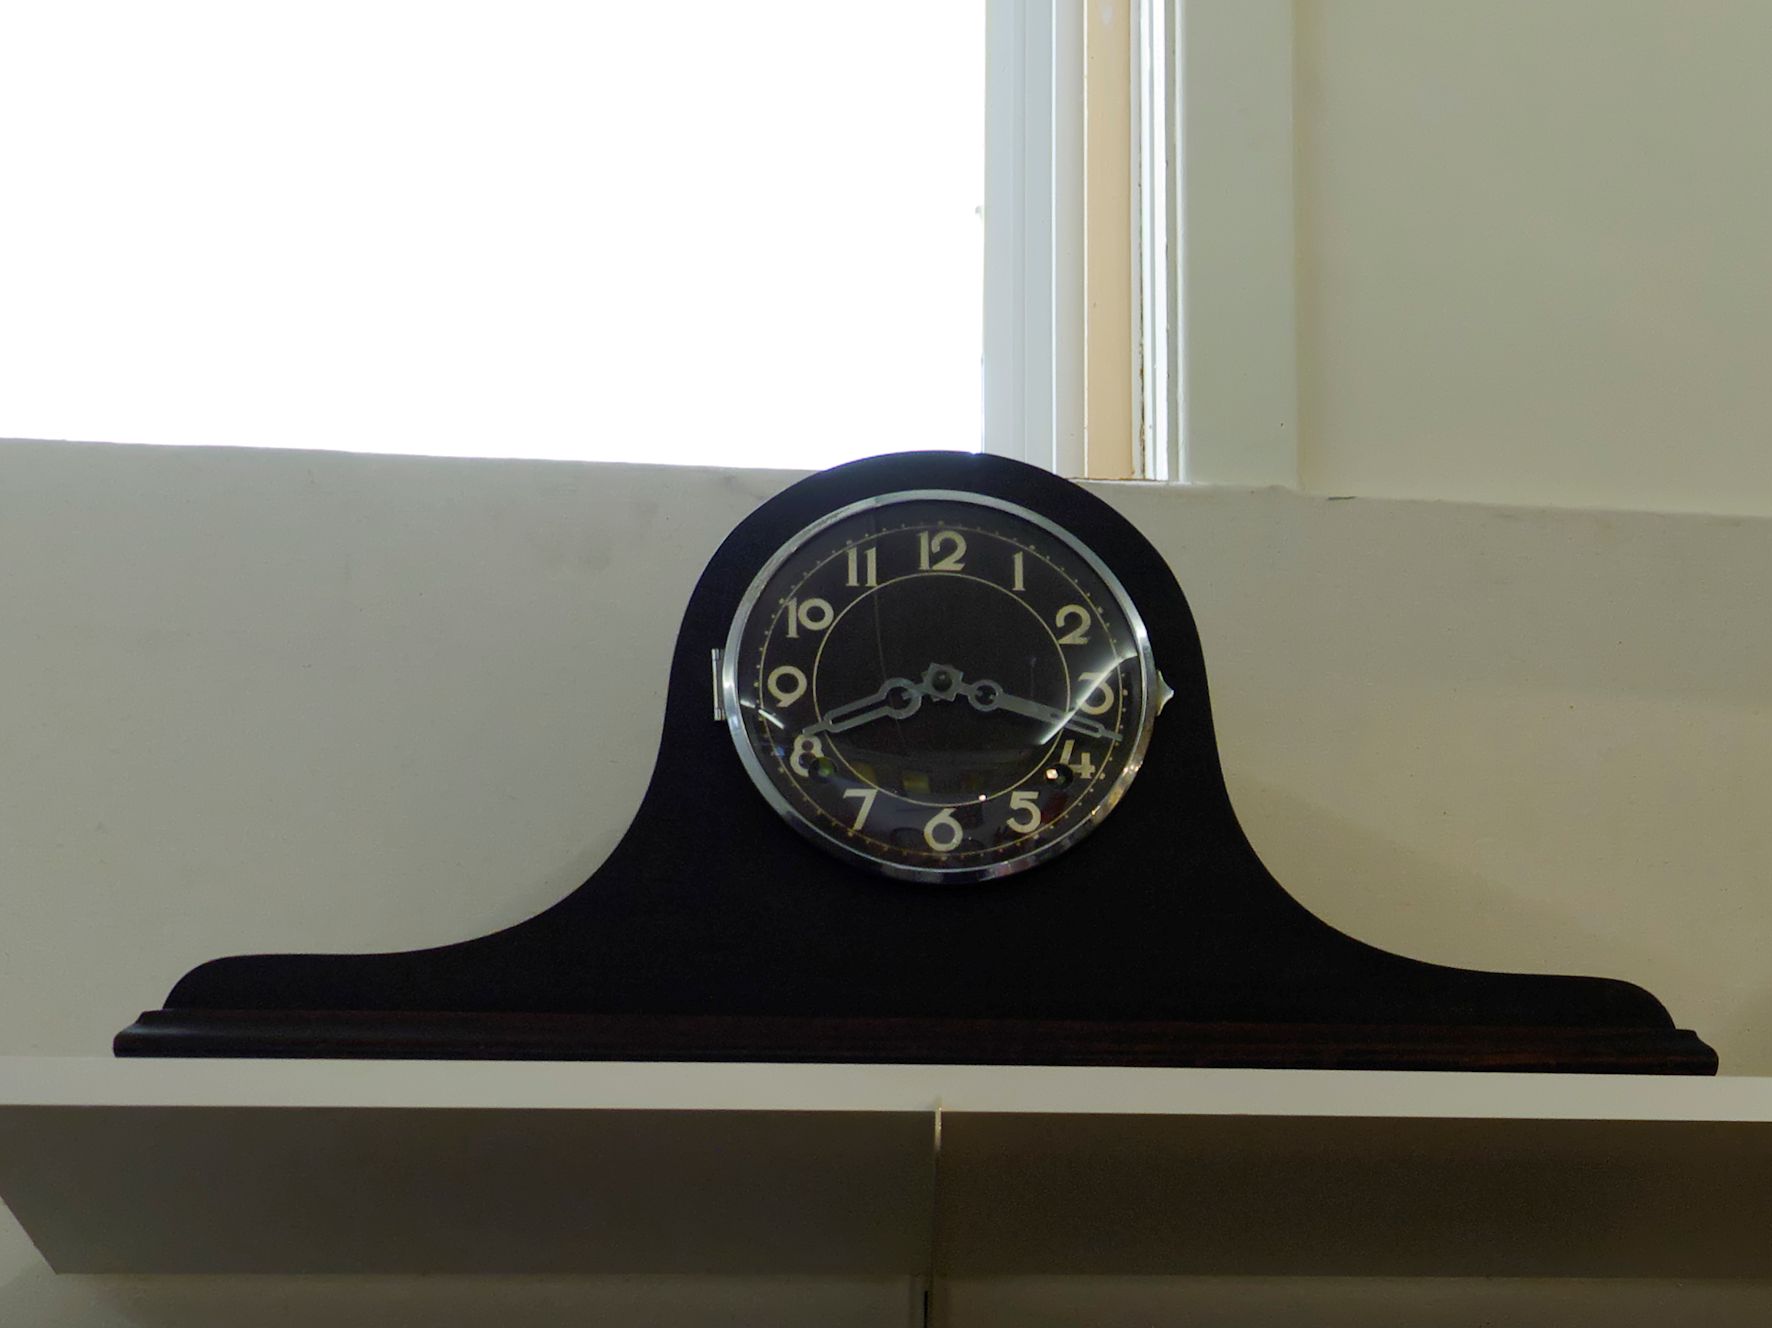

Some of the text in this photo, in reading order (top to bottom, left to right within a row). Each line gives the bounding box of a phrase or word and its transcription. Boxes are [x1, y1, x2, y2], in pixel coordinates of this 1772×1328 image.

[846, 546, 878, 587] 11
[917, 530, 967, 571] 12
[1013, 551, 1026, 591] 1
[785, 598, 834, 638] 10
[1055, 604, 1091, 645] 2
[766, 665, 808, 707] 9
[1078, 672, 1114, 715] 3
[790, 734, 824, 777] 8
[1058, 739, 1096, 778] 4
[842, 789, 879, 830] 7
[923, 808, 963, 852] 6
[1006, 791, 1041, 833] 5
